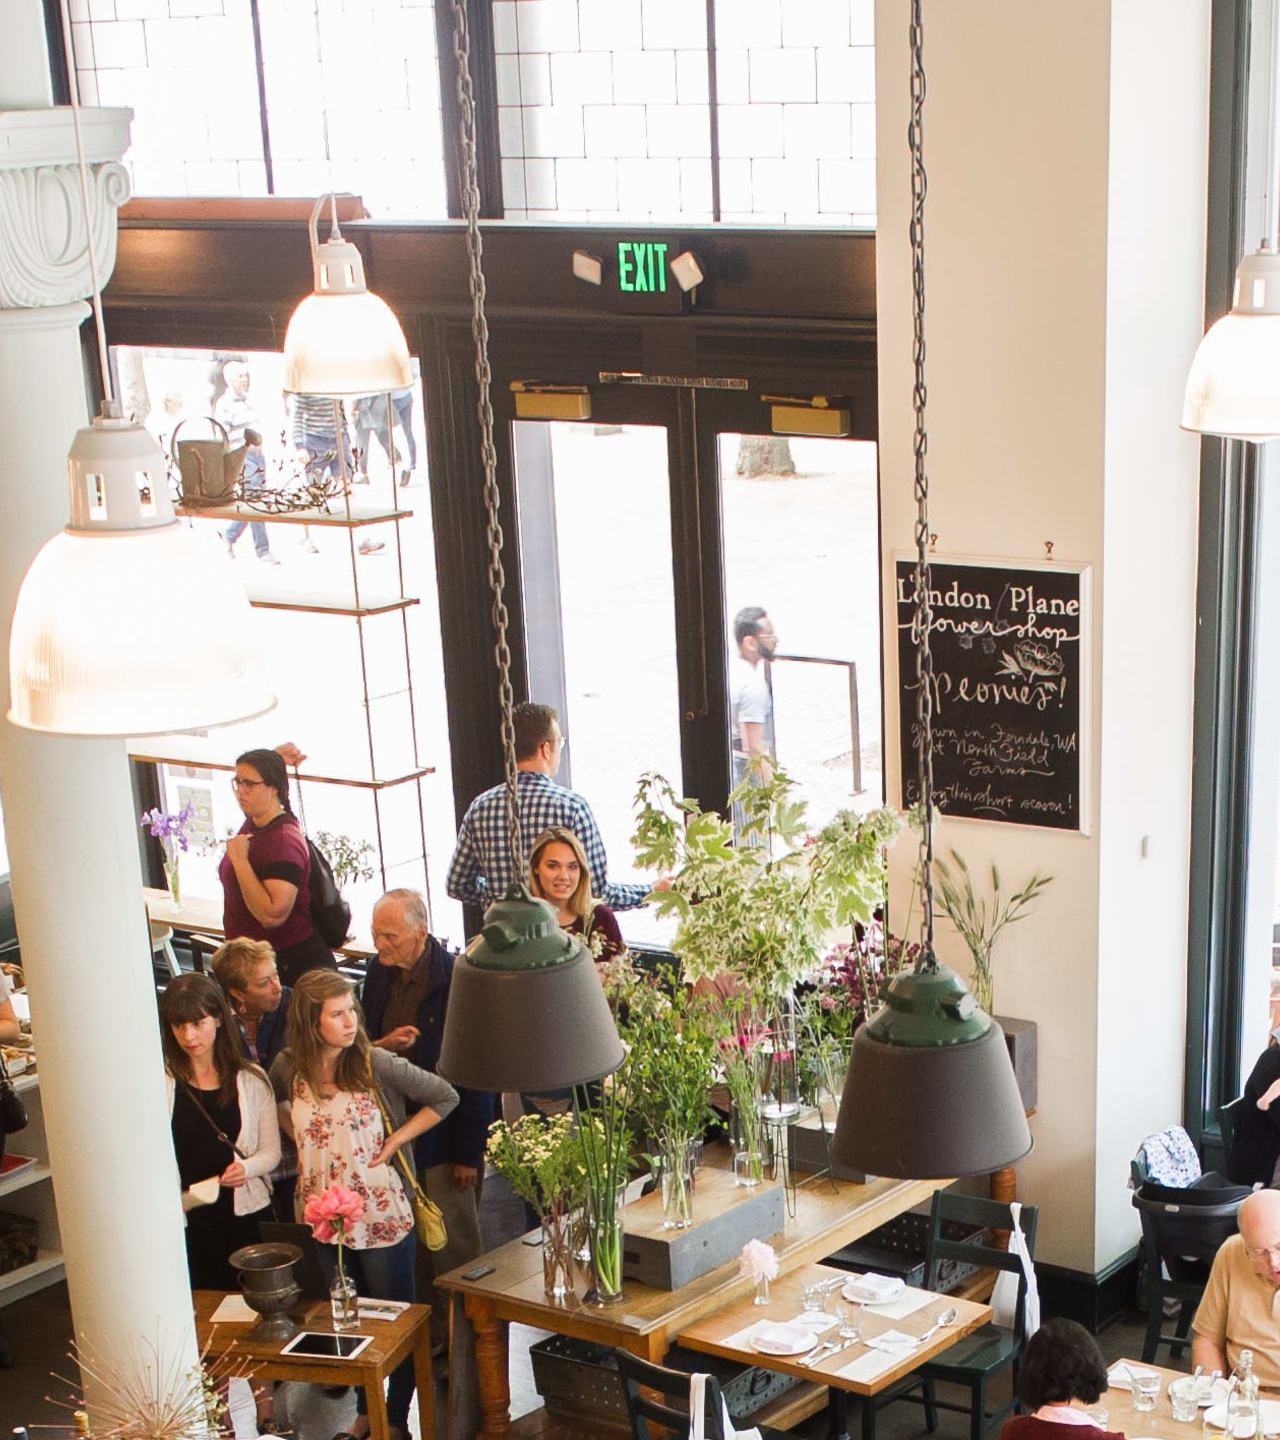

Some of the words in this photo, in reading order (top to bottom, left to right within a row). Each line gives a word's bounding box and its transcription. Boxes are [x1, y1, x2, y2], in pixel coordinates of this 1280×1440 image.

[618, 242, 668, 292] EXIT
[1010, 586, 1080, 616] Plane
[1015, 613, 1080, 648] shop
[949, 739, 998, 758] North
[999, 743, 1050, 767] Field
[964, 729, 985, 740] in
[1054, 732, 1078, 752] WA
[963, 758, 1055, 777] Farms
[944, 782, 971, 802] this
[1020, 794, 1073, 814] season!
